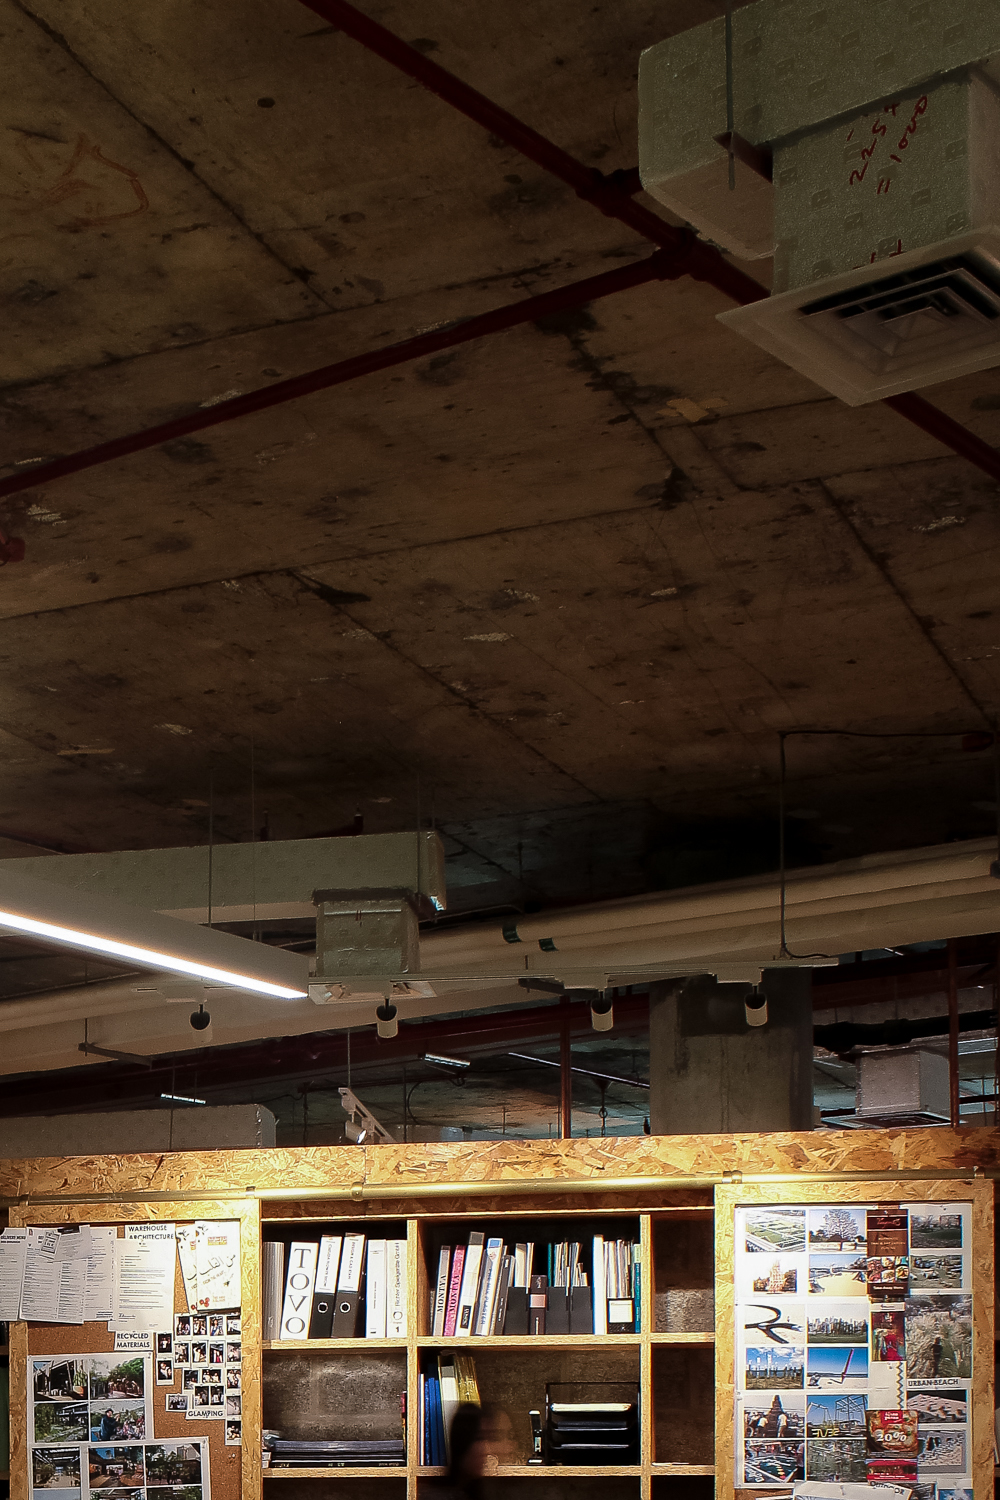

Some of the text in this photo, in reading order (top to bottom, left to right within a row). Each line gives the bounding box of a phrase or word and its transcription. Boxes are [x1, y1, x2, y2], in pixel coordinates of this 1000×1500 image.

[285, 1248, 311, 1334] TOVO
[188, 1410, 223, 1418] GLAMPING
[876, 1431, 907, 1442] 20%
